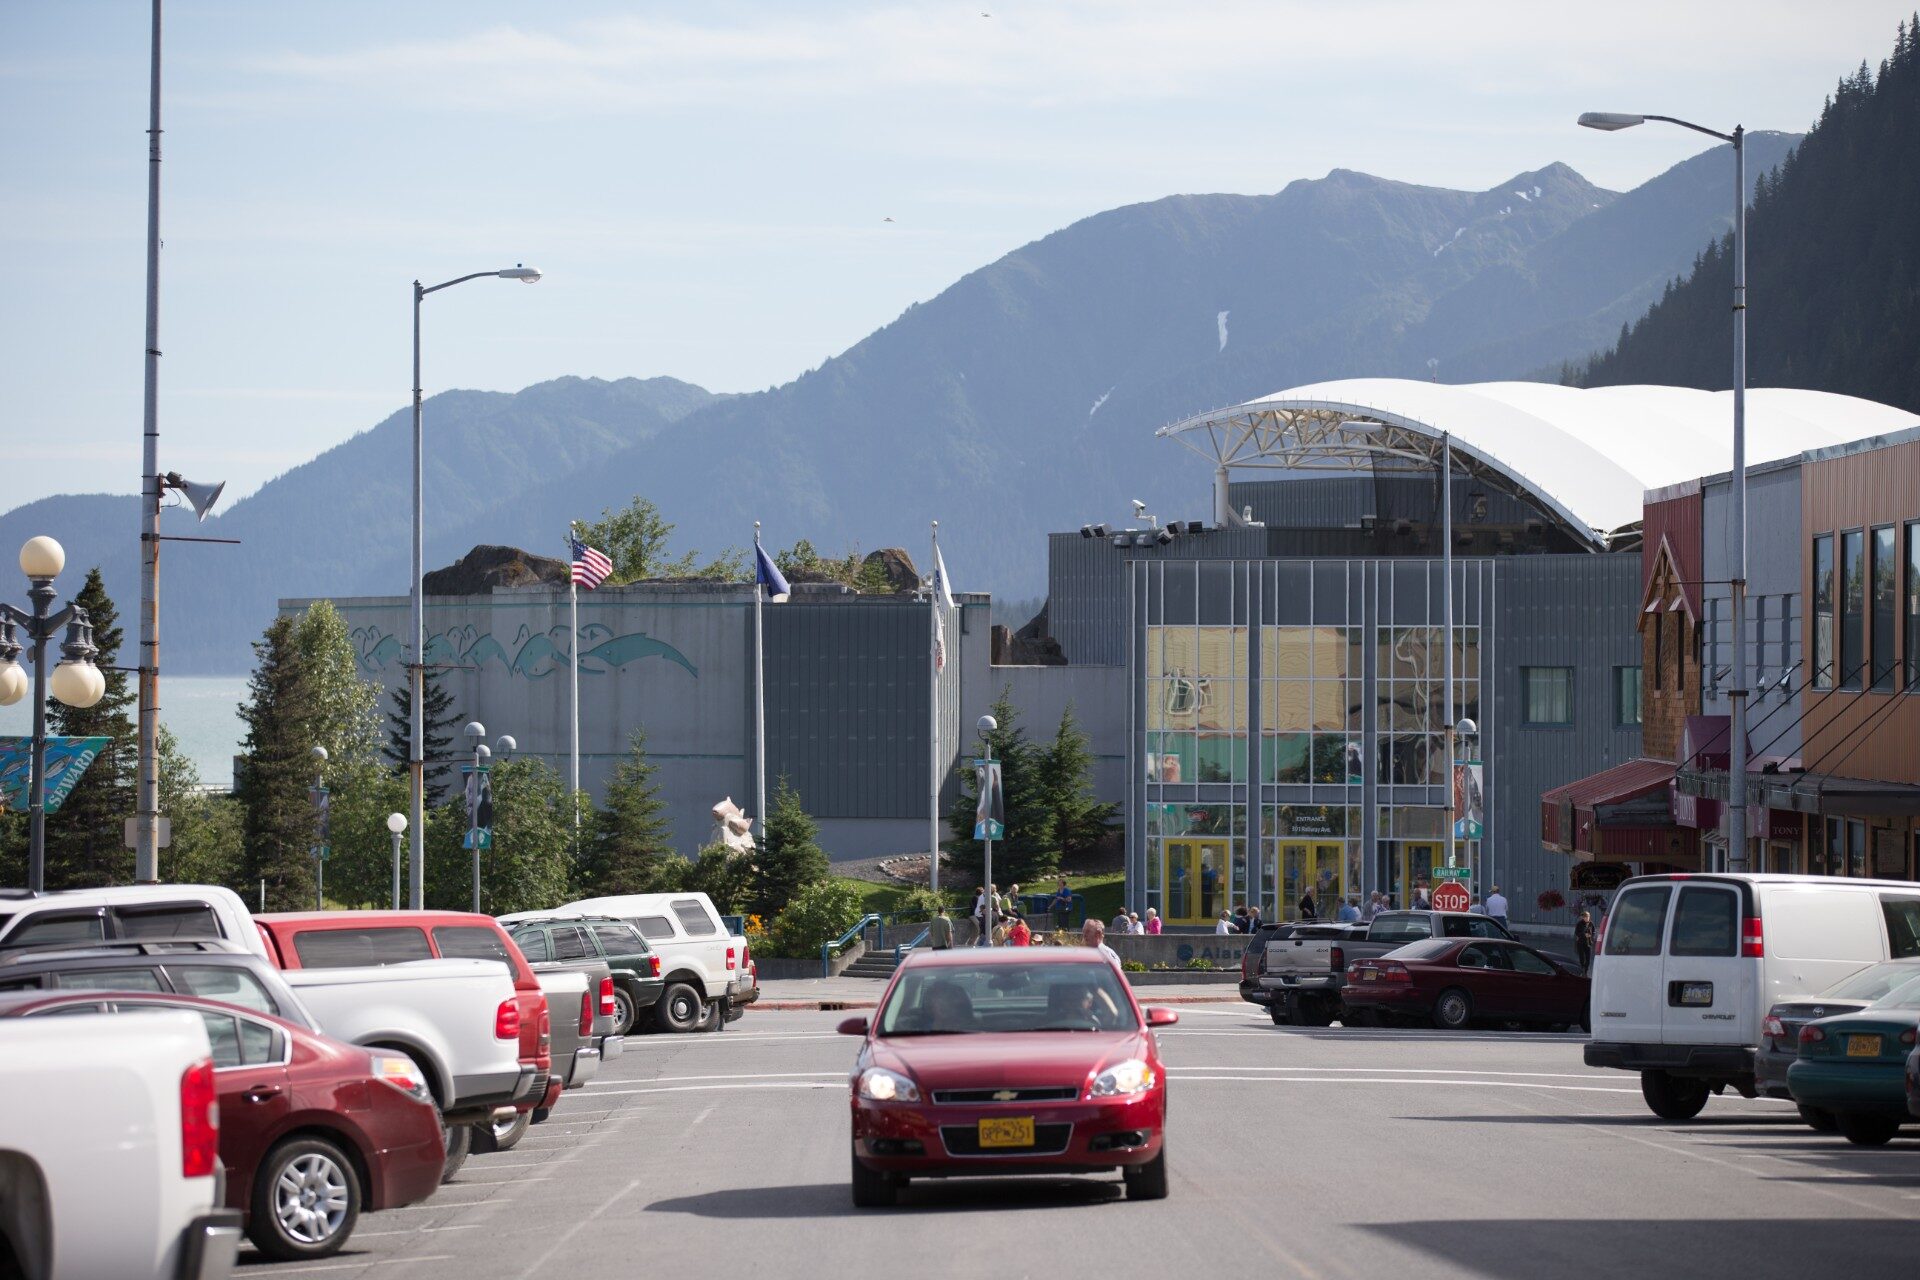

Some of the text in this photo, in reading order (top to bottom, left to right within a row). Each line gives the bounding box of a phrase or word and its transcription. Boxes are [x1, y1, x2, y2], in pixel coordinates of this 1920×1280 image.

[48, 749, 95, 809] SEWARD
[1436, 868, 1460, 877] RAILWAY
[1435, 894, 1468, 909] STOP
[1201, 945, 1245, 959] Alas
